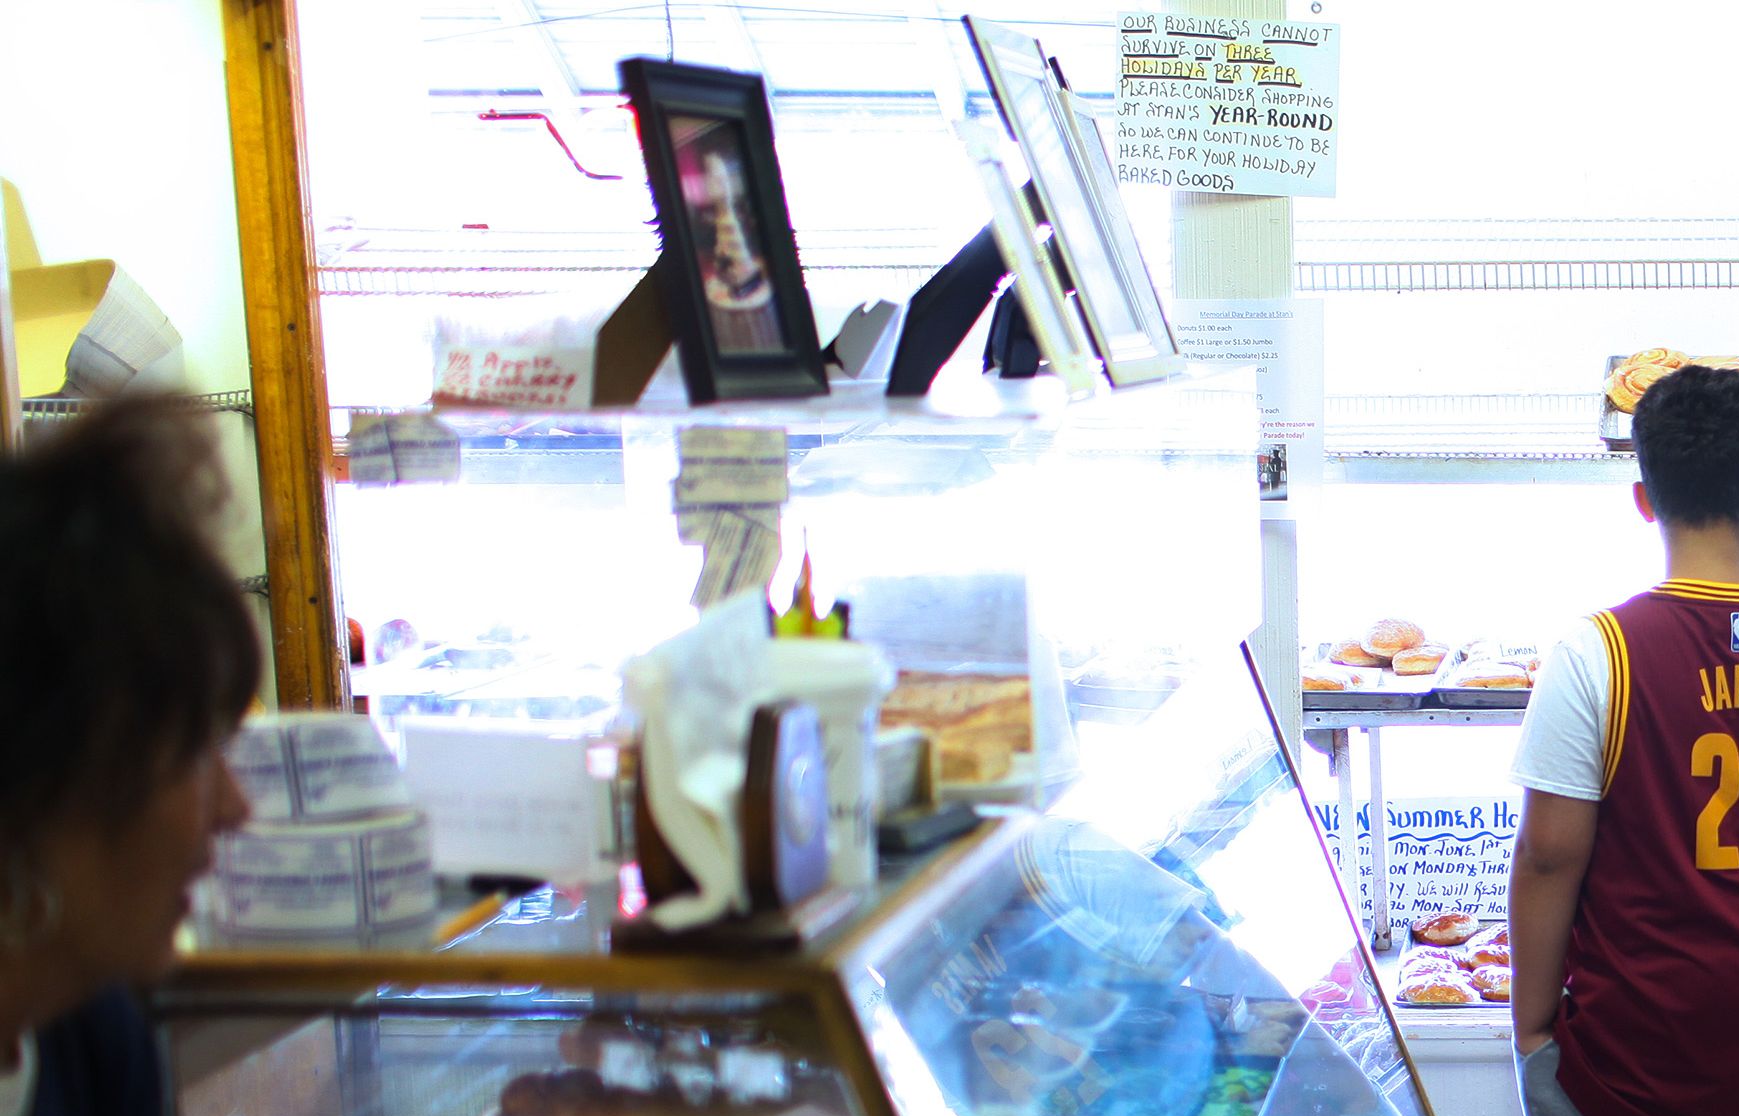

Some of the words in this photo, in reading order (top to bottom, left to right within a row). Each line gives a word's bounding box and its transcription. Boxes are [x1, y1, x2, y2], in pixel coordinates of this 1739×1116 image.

[1123, 15, 1155, 33] OUR
[1165, 16, 1250, 38] BUSINESS
[1262, 23, 1332, 43] CANNOT
[1121, 35, 1190, 55] SURVIVE
[1194, 43, 1216, 57] ON
[1222, 43, 1274, 61] THREE
[1121, 58, 1205, 77] HOLIDAYS
[1214, 63, 1241, 80] PER
[1251, 66, 1297, 84] YEAR
[1119, 78, 1180, 98] PLEASE
[1183, 83, 1255, 106] CONSIDER
[1262, 88, 1333, 108] SHOPPING
[1117, 102, 1139, 118] AT
[1148, 103, 1200, 120] STAN'S
[1209, 104, 1333, 131] YEAR-ROUND
[1118, 122, 1136, 137] SO
[1141, 127, 1163, 138] WE
[1167, 129, 1197, 142] CAN
[1204, 130, 1282, 148] CONTINUE
[1285, 135, 1304, 151] TO
[1311, 138, 1330, 155] BE
[1119, 144, 1163, 160] HERE
[1168, 146, 1197, 161] FOR
[1202, 149, 1236, 168] YOUR
[1242, 154, 1315, 178] HOLIDAY
[1119, 164, 1172, 186] BAKED
[1177, 170, 1234, 191] GOODS
[1205, 339, 1223, 347] Large
[1434, 839, 1475, 856] JUNE
[1417, 880, 1437, 896] WE
